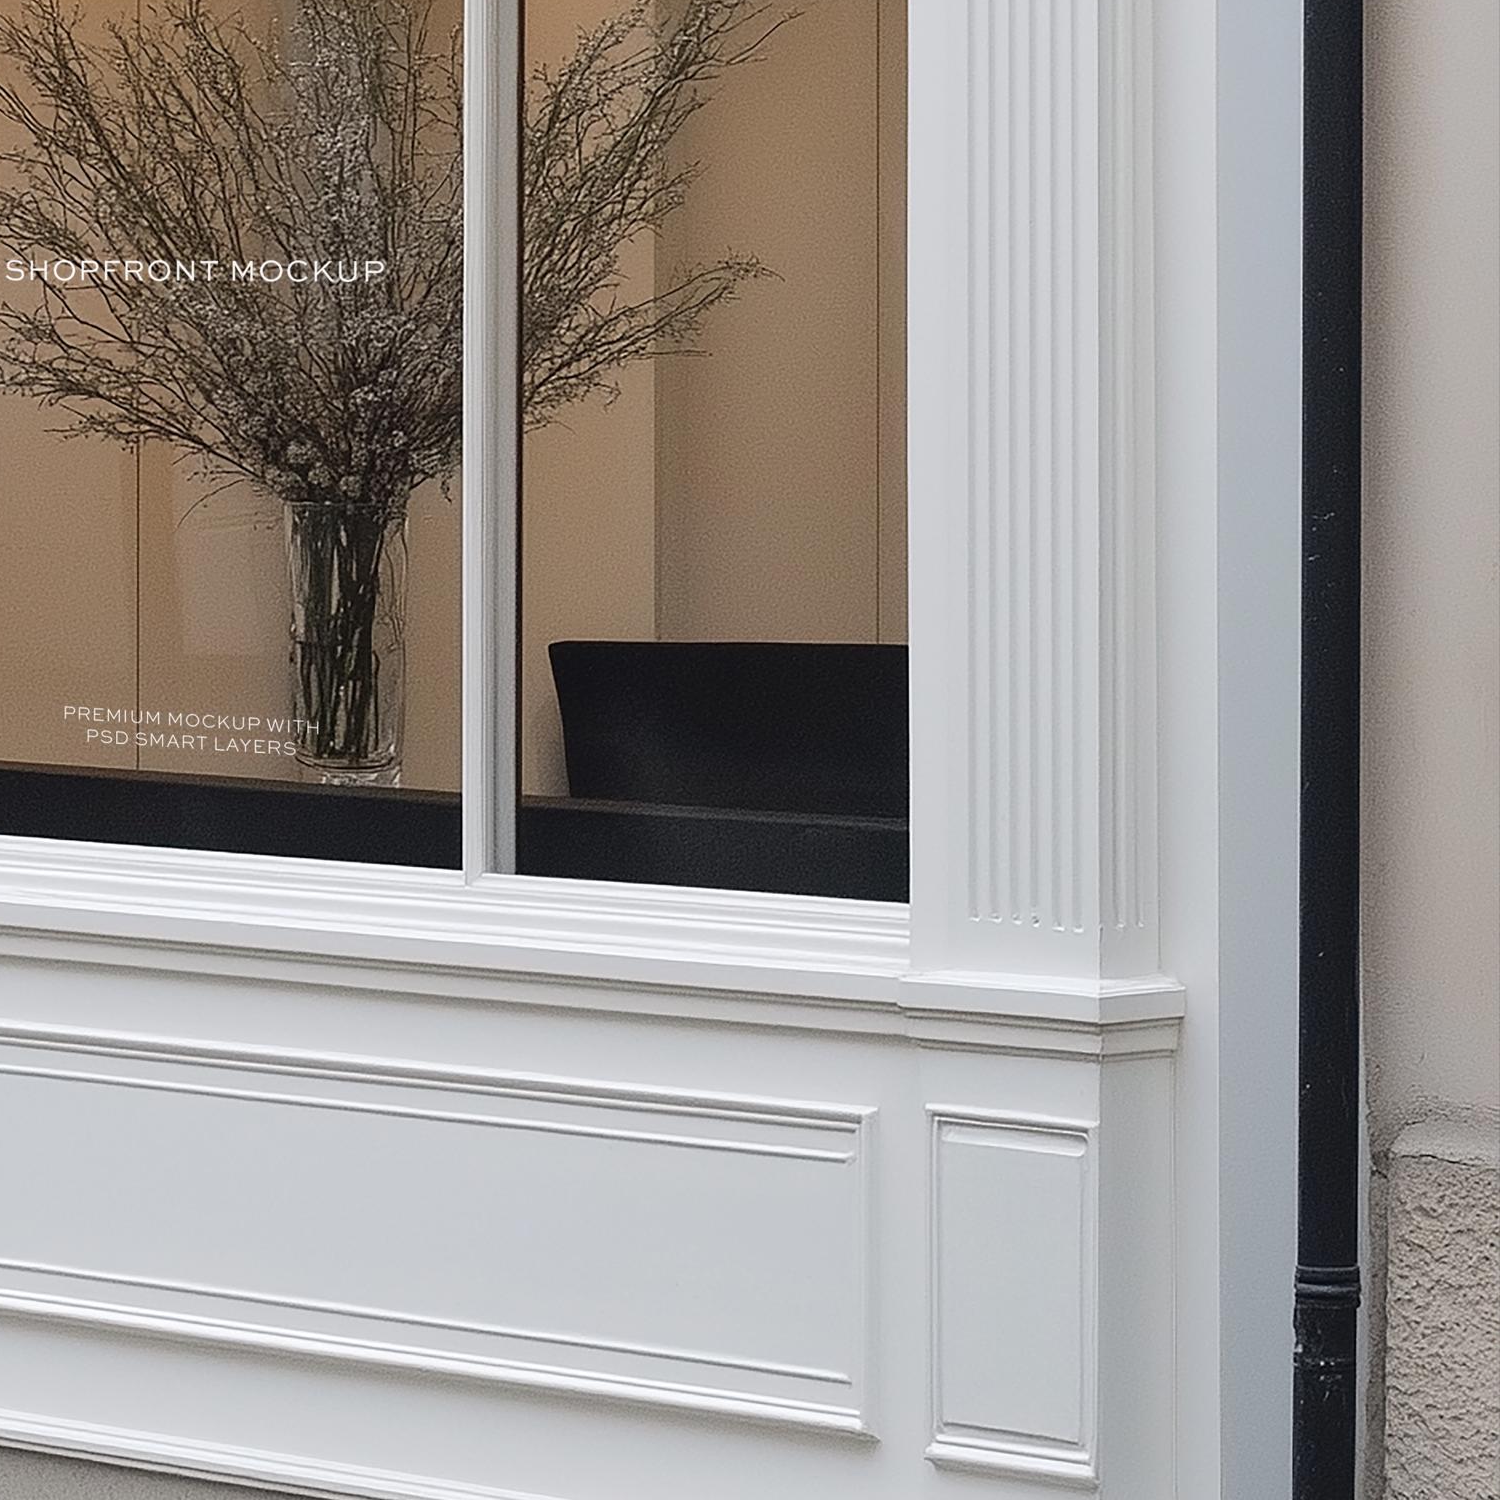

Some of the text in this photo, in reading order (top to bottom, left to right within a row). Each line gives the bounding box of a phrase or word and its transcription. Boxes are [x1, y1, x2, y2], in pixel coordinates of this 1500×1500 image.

[4, 258, 386, 282] SHOPFRONT MOCKUP
[63, 706, 319, 735] PREMIUM MOCKUP WITH
[86, 729, 297, 756] PSD SMART LAYERS
